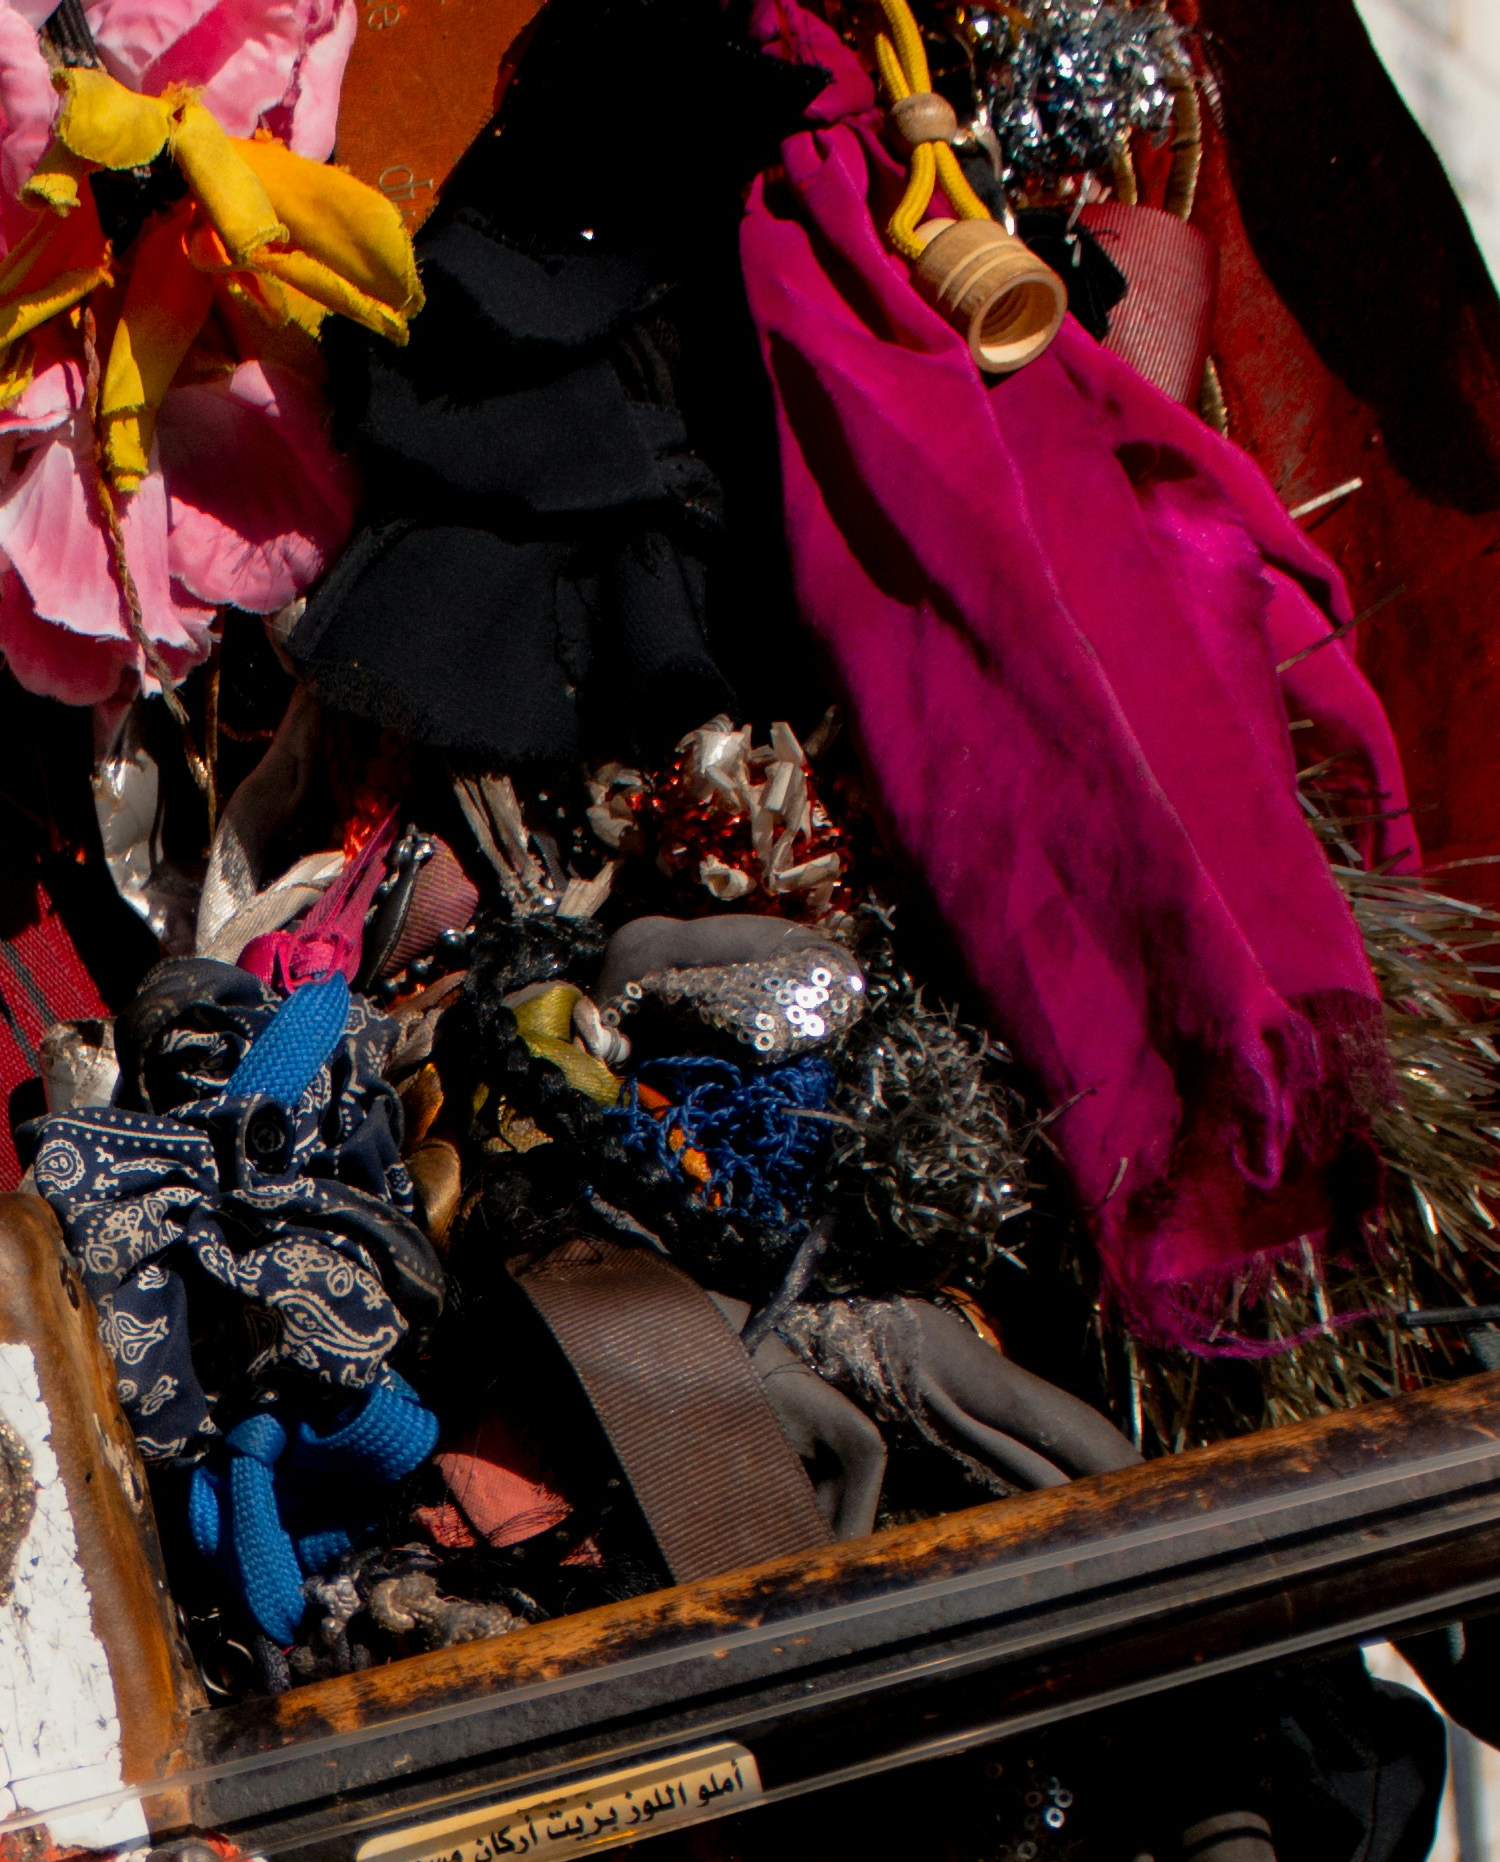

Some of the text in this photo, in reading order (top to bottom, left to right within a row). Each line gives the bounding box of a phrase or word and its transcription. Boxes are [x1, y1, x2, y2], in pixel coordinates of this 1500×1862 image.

[625, 1780, 687, 1825] اللوز
[696, 1758, 744, 1808] أملو
[546, 1800, 618, 1842] بزيت
